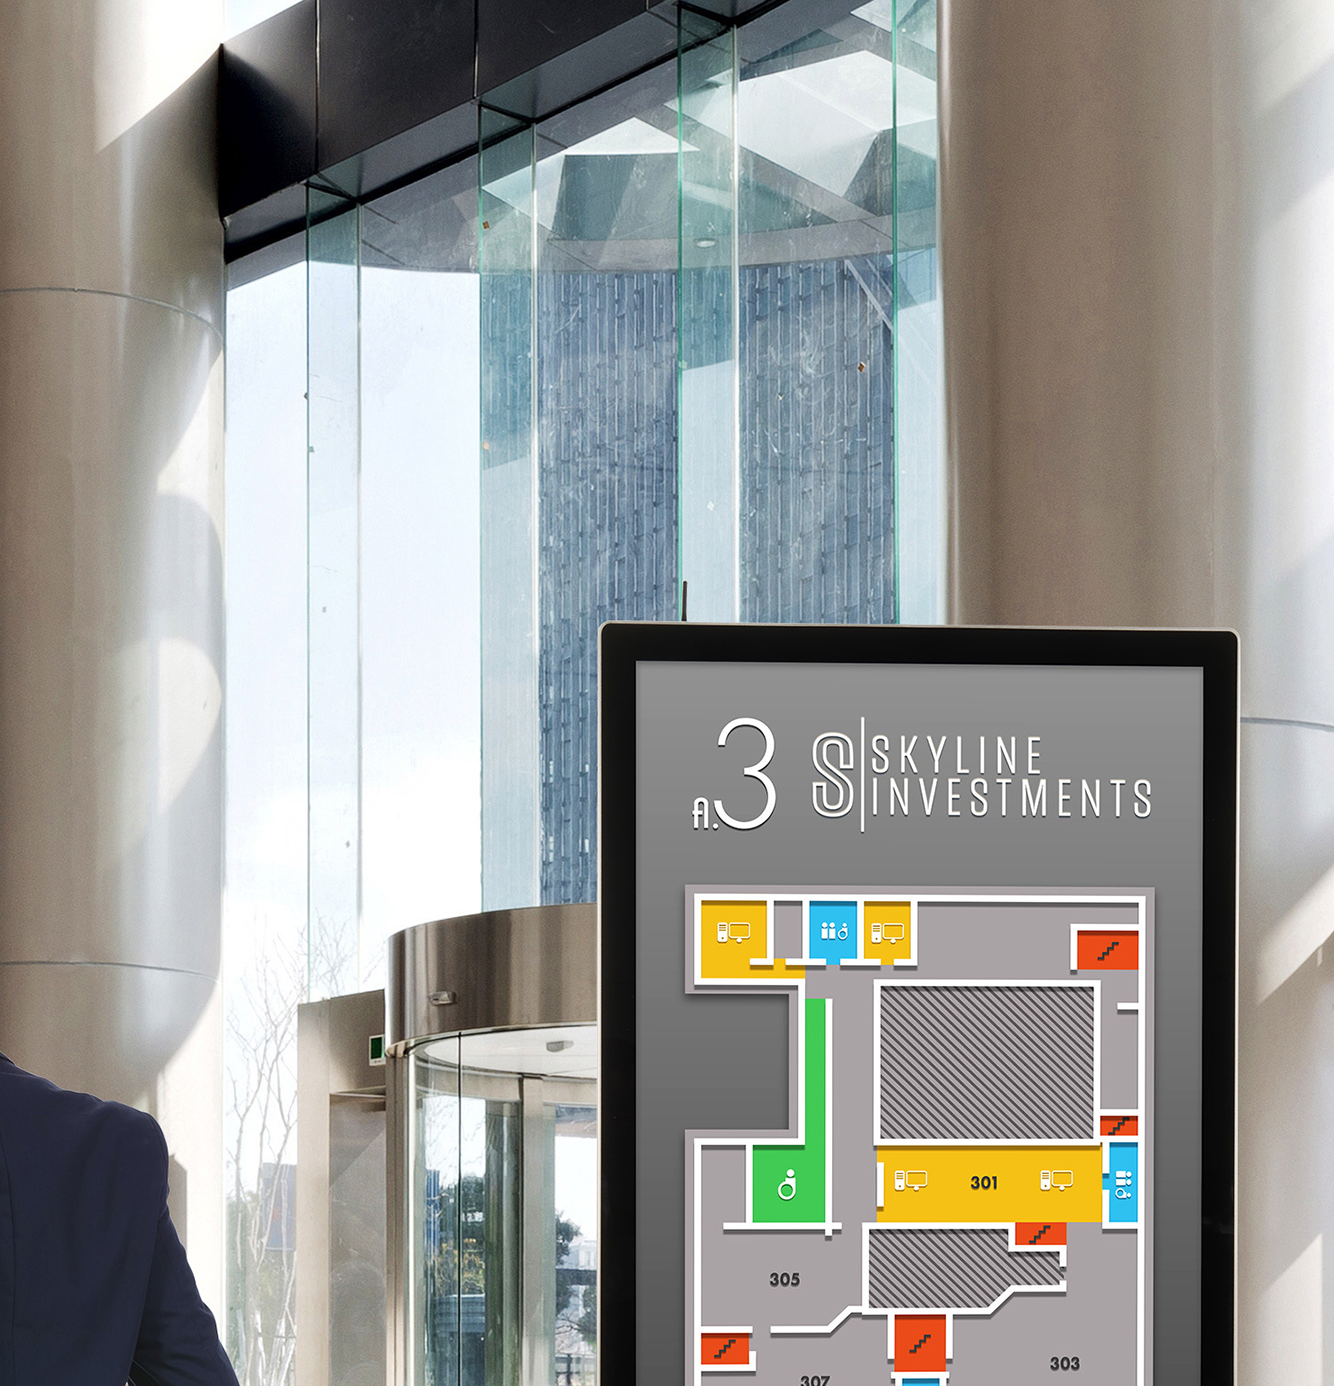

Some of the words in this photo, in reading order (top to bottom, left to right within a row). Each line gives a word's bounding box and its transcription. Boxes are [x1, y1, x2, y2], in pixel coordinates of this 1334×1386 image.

[871, 735, 1042, 775] SKYLINE
[871, 777, 1153, 818] INVESTMENTS
[970, 1176, 998, 1191] 301
[769, 1272, 800, 1288] 305
[1050, 1357, 1081, 1372] 303
